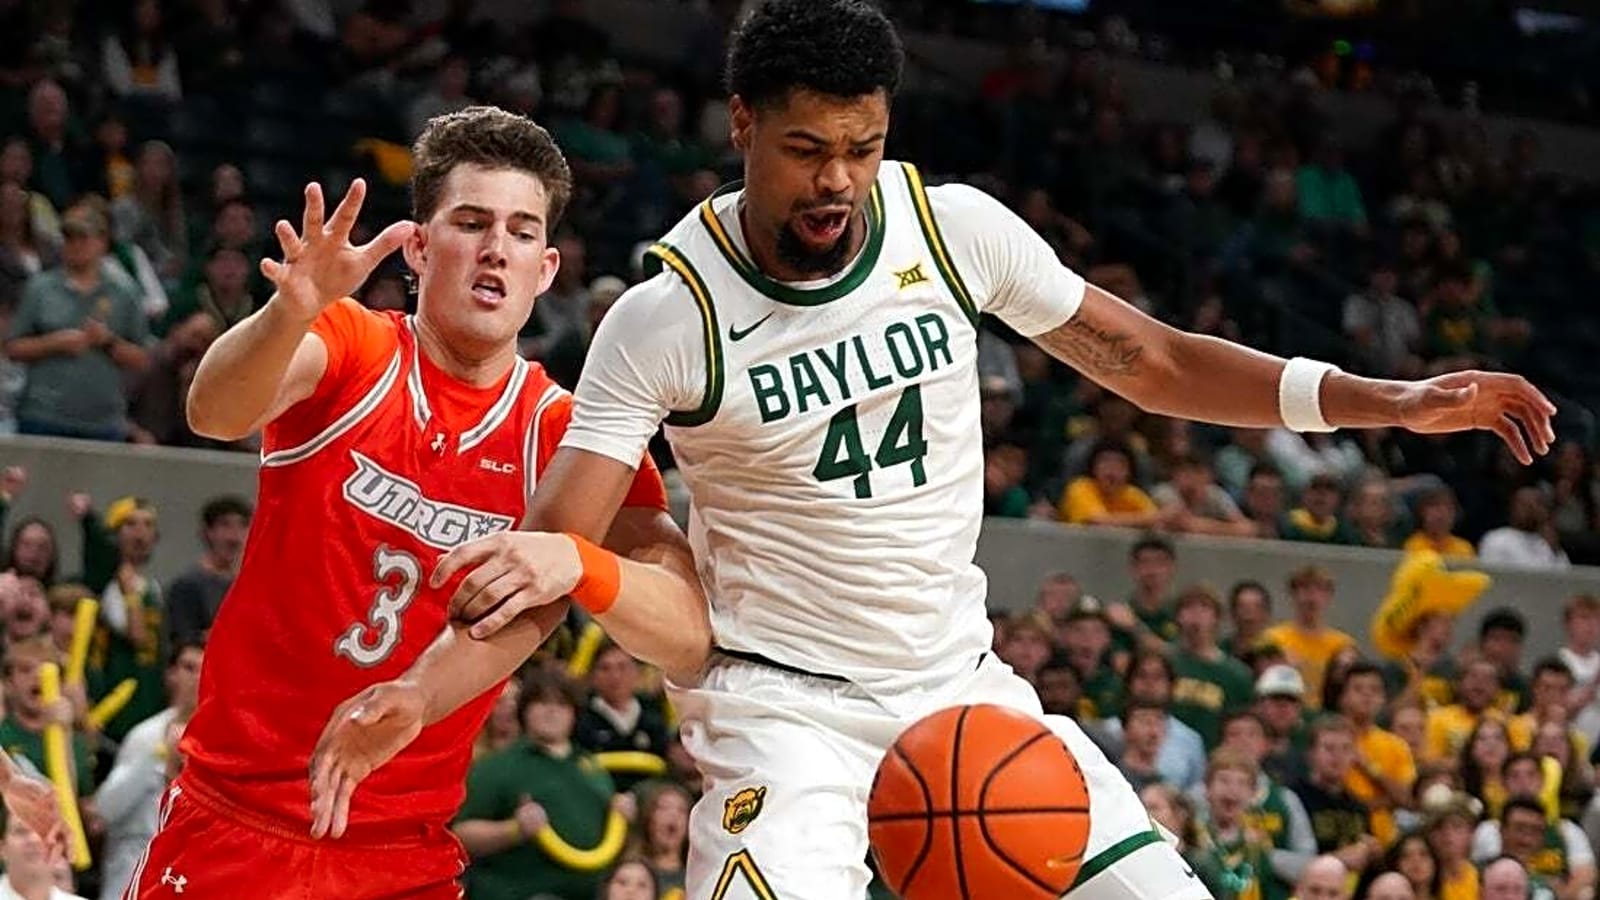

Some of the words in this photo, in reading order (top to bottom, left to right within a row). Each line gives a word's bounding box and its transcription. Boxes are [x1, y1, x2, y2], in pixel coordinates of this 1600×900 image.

[893, 263, 928, 289] XII
[748, 313, 953, 424] BAYLOR
[480, 458, 517, 474] SLC
[812, 383, 928, 499] 44
[335, 543, 422, 668] 3
